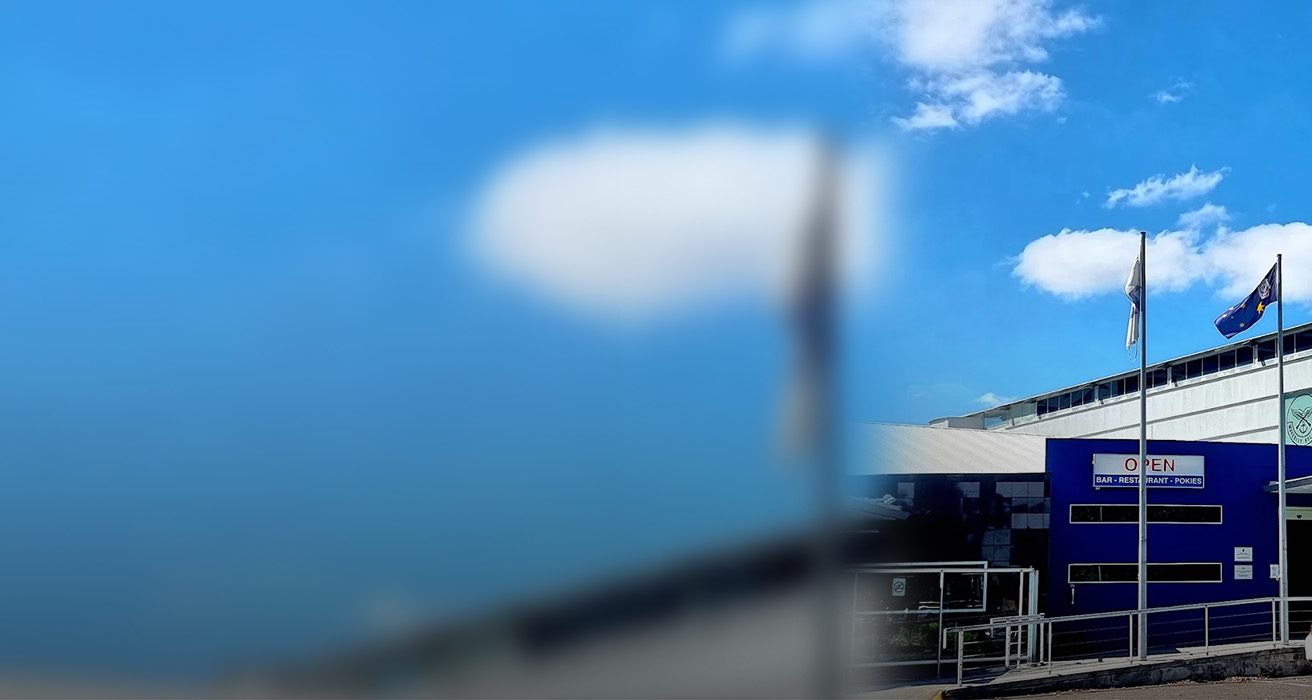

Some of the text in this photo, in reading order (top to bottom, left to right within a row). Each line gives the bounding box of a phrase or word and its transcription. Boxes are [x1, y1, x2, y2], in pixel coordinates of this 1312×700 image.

[1096, 476, 1113, 484] BAR
[1119, 476, 1169, 485] RESTRANT
[1174, 477, 1202, 485] POKIES
